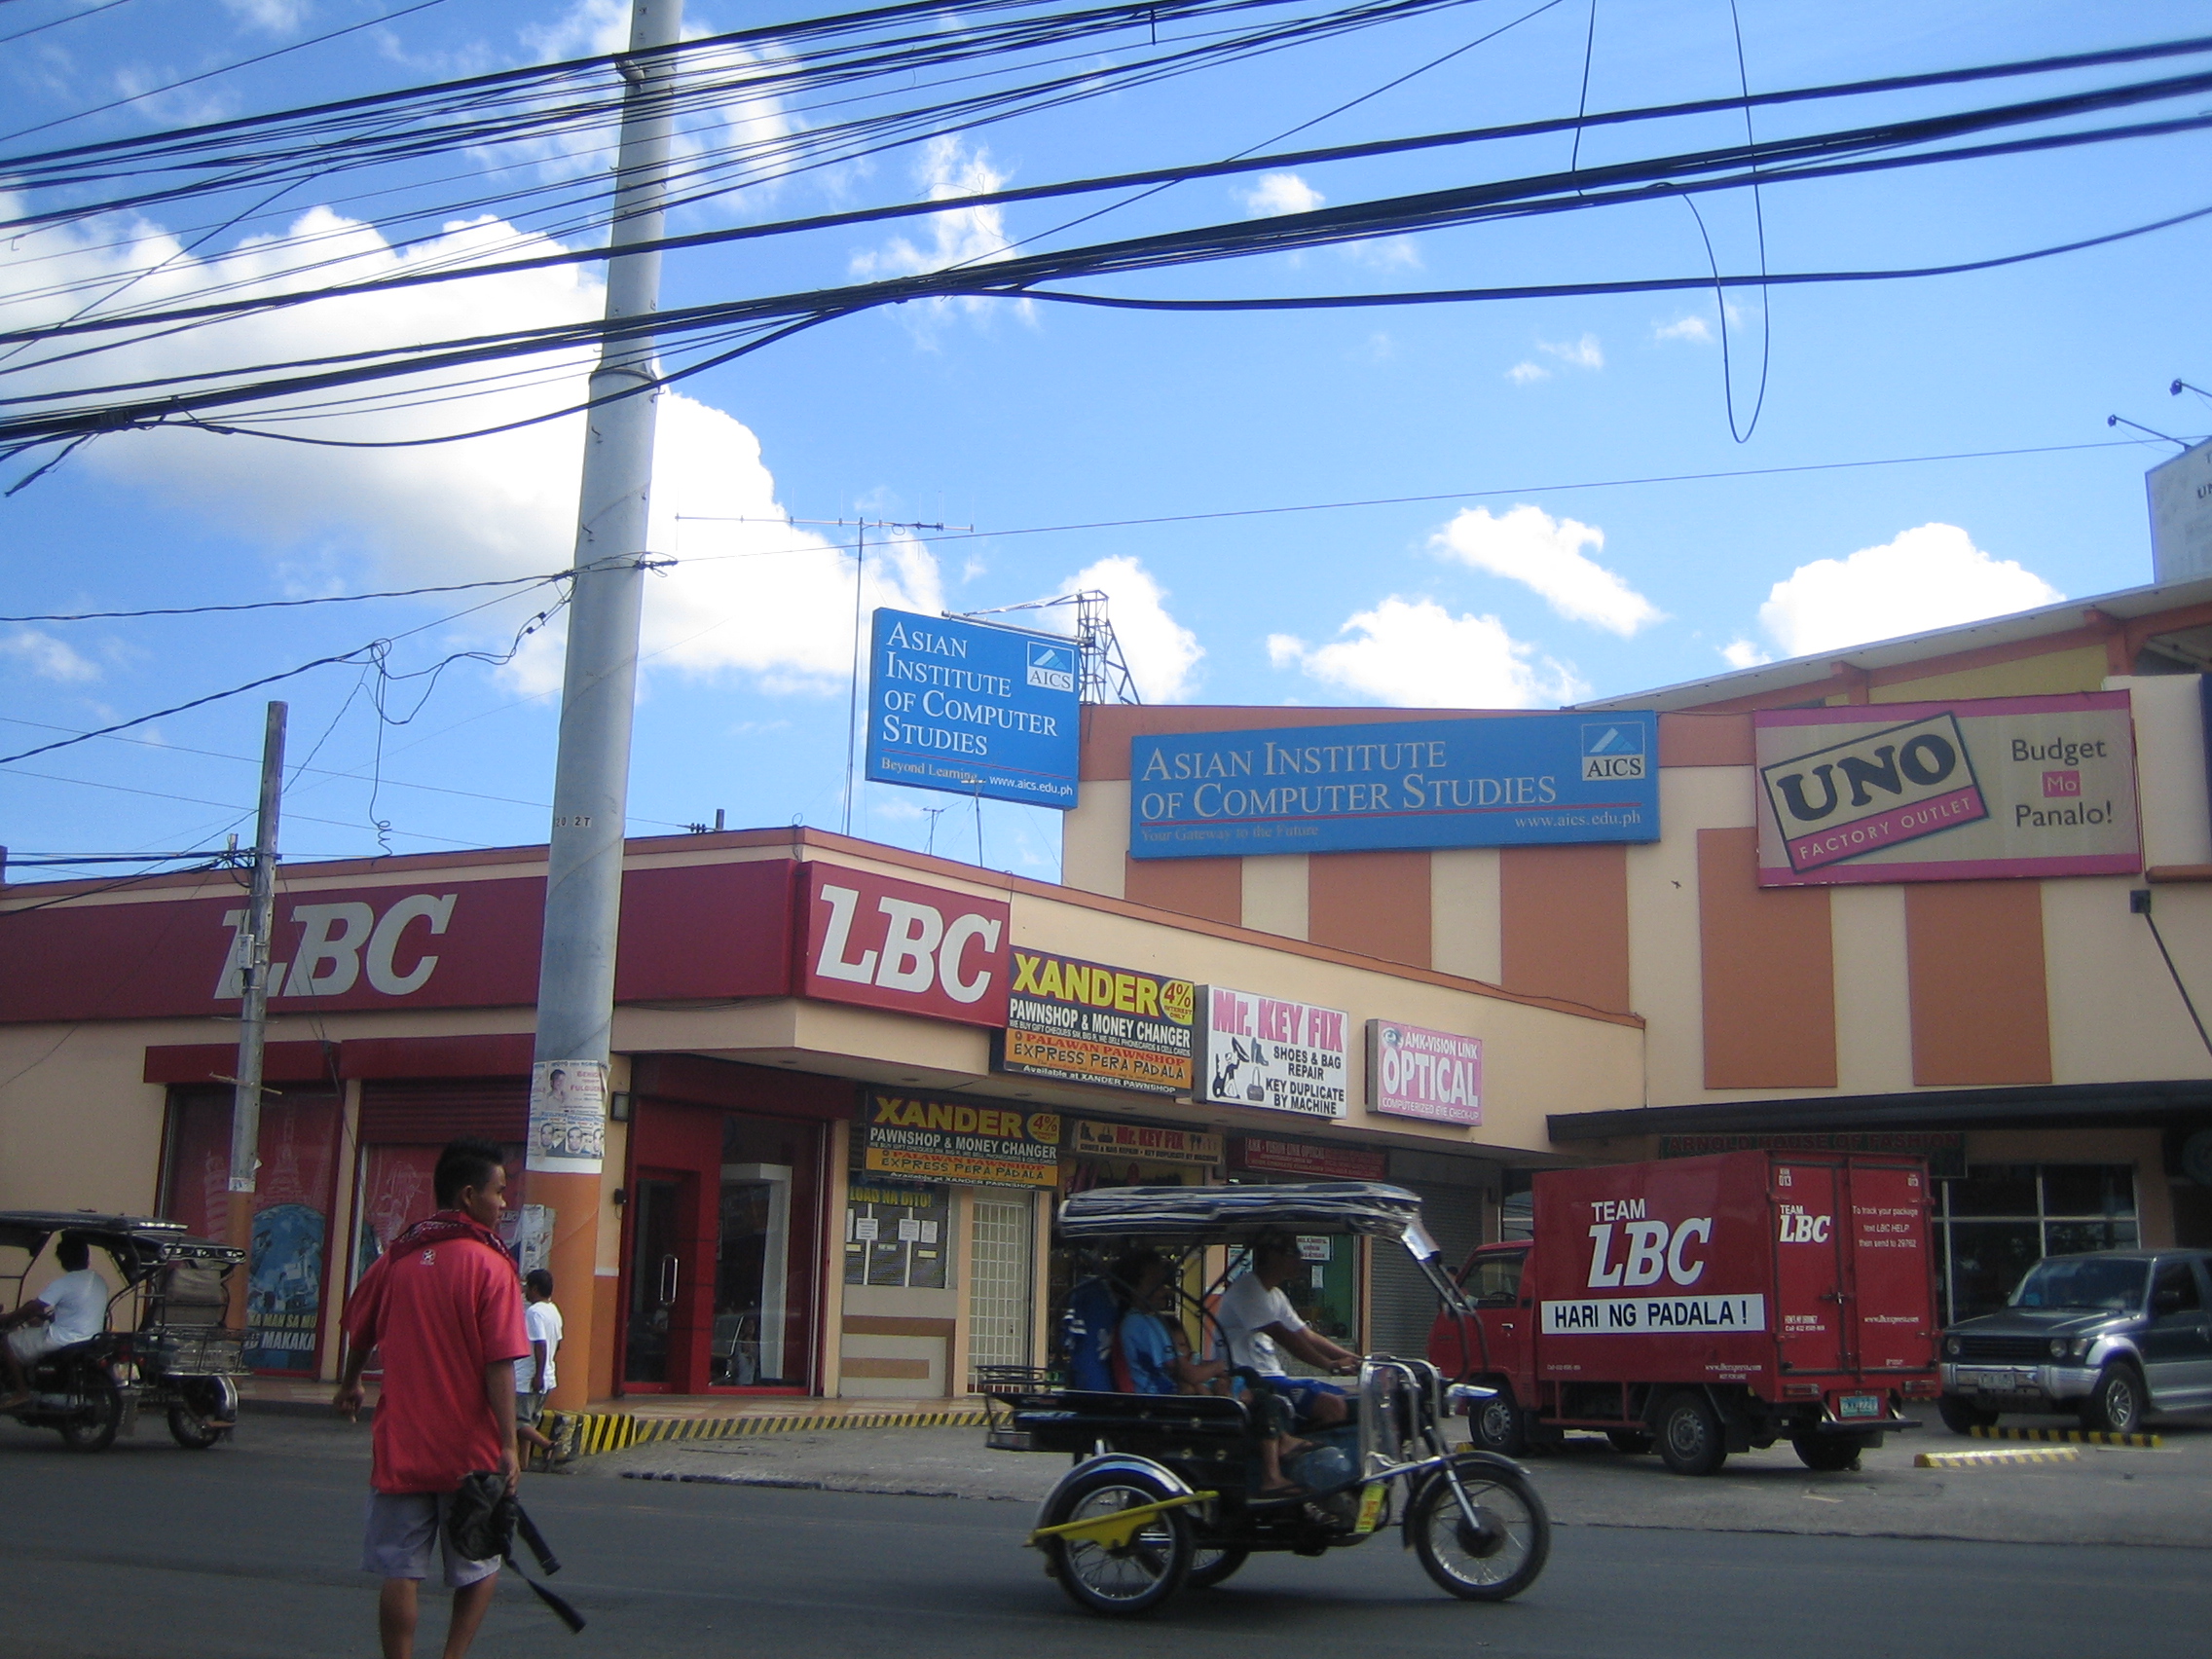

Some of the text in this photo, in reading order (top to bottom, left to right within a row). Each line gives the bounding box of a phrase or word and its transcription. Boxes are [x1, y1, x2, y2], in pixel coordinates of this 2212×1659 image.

[886, 621, 968, 659] ASIAN
[886, 651, 1013, 698] INSTITUTE
[1029, 670, 1072, 689] AICS
[922, 689, 1058, 737] COMPUTER
[883, 715, 989, 756] STUDIES
[881, 756, 925, 774] Beyond
[1141, 740, 1447, 781] ASIAN INSTITUTE
[2010, 738, 2107, 765] Budget
[1586, 757, 1642, 778] AICS
[1777, 733, 1956, 822] UNO
[988, 774, 1073, 797] www.aics.edu.ph
[1194, 782, 1392, 818] COMPUTER
[1402, 772, 1557, 809] STUDIES
[2046, 775, 2078, 793] Mo
[1514, 809, 1642, 829] www.aics.edu.ph
[2015, 800, 2113, 828] Panalo!
[1141, 824, 1318, 844] Your Gateway to the Future
[1798, 795, 1972, 861] FACTORY OUTLET
[213, 893, 459, 999] LBC
[815, 883, 1002, 1004] LBC
[1012, 952, 1160, 1017] XANDER
[1164, 981, 1191, 1008] 4%
[1010, 997, 1191, 1049] PAWNSHOP & MONEY CHANGER
[1213, 989, 1344, 1052] Mr. KEY FIX
[1014, 1043, 1086, 1065] EXPRESS
[1090, 1052, 1130, 1071] PERA
[1133, 1060, 1185, 1081] PADALA
[1026, 1033, 1185, 1067] PALAWAN PAWNSHOP
[1273, 1045, 1342, 1069] SHOES & BAG
[1457, 1042, 1478, 1059] LINK
[1022, 1064, 1068, 1077] Available
[1081, 1073, 1122, 1087] XANDER
[1123, 1080, 1176, 1093] PAWNSHOP
[1288, 1063, 1324, 1081] REPAIR
[1382, 1047, 1479, 1108] OPTICAL
[1266, 1078, 1345, 1102] KEY DUPLICATE
[873, 1095, 1024, 1139] XANDER
[1273, 1094, 1337, 1115] BY MACHINE
[1382, 1097, 1434, 1115] COMPUTERIZED
[1032, 1115, 1057, 1131] 4%
[869, 1126, 941, 1147] PAWNSHOP
[943, 1136, 952, 1148] &
[955, 1136, 999, 1154] MONEY
[1002, 1140, 1057, 1159] CHANGER
[1139, 1127, 1163, 1148] KEY
[1165, 1130, 1184, 1150] FIX
[1868, 1132, 1960, 1148] FASHION
[881, 1158, 948, 1172] EXPRESS
[954, 1163, 992, 1176] PERA
[996, 1167, 1045, 1180] PADALA
[893, 1151, 963, 1164] PALAWAN
[967, 1158, 1045, 1171] PAWNSHOP
[1591, 1198, 1645, 1222] TEAM
[1780, 1204, 1804, 1215] TEAM
[1852, 1205, 1862, 1215] To
[1892, 1207, 1919, 1218] package
[1779, 1214, 1831, 1243] LBC
[1876, 1224, 1891, 1233] LBC
[1891, 1224, 1910, 1233] HELP
[1587, 1217, 1712, 1288] LBC
[1555, 1305, 1599, 1328] HARI
[1609, 1303, 1637, 1327] NG
[1648, 1301, 1734, 1326] PADALA
